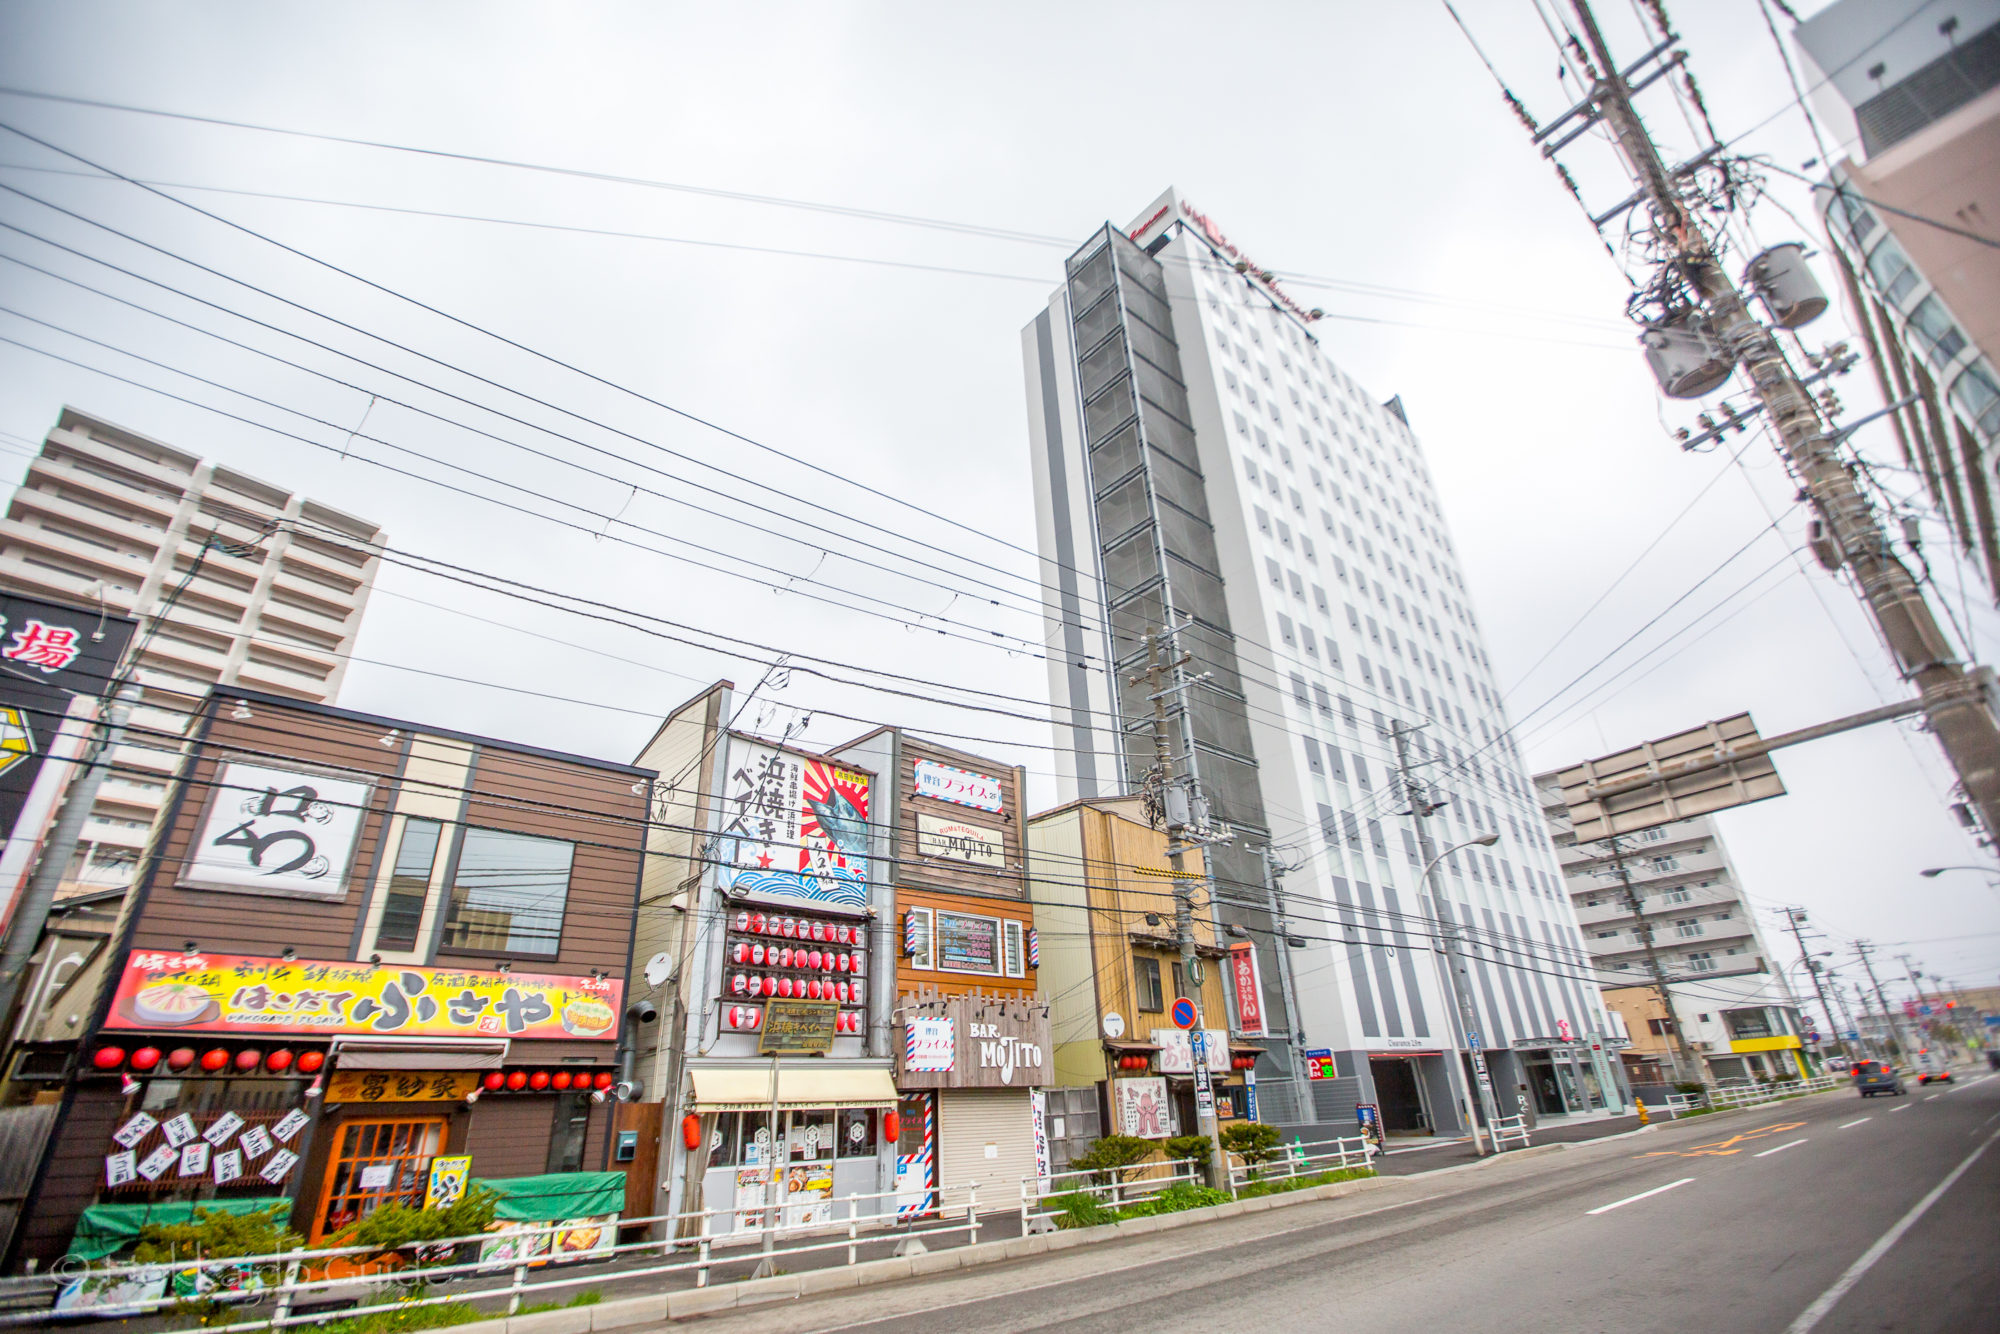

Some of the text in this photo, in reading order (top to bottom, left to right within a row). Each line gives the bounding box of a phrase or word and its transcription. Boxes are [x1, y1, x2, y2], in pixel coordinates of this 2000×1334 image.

[0, 614, 80, 673] 場
[941, 776, 988, 799] プライス
[933, 836, 992, 860] BAR MOJITO
[229, 983, 355, 1015] はこだて
[351, 970, 552, 1033] ふさや
[969, 1022, 1001, 1039] BAR
[980, 1036, 1042, 1086] MOJITO
